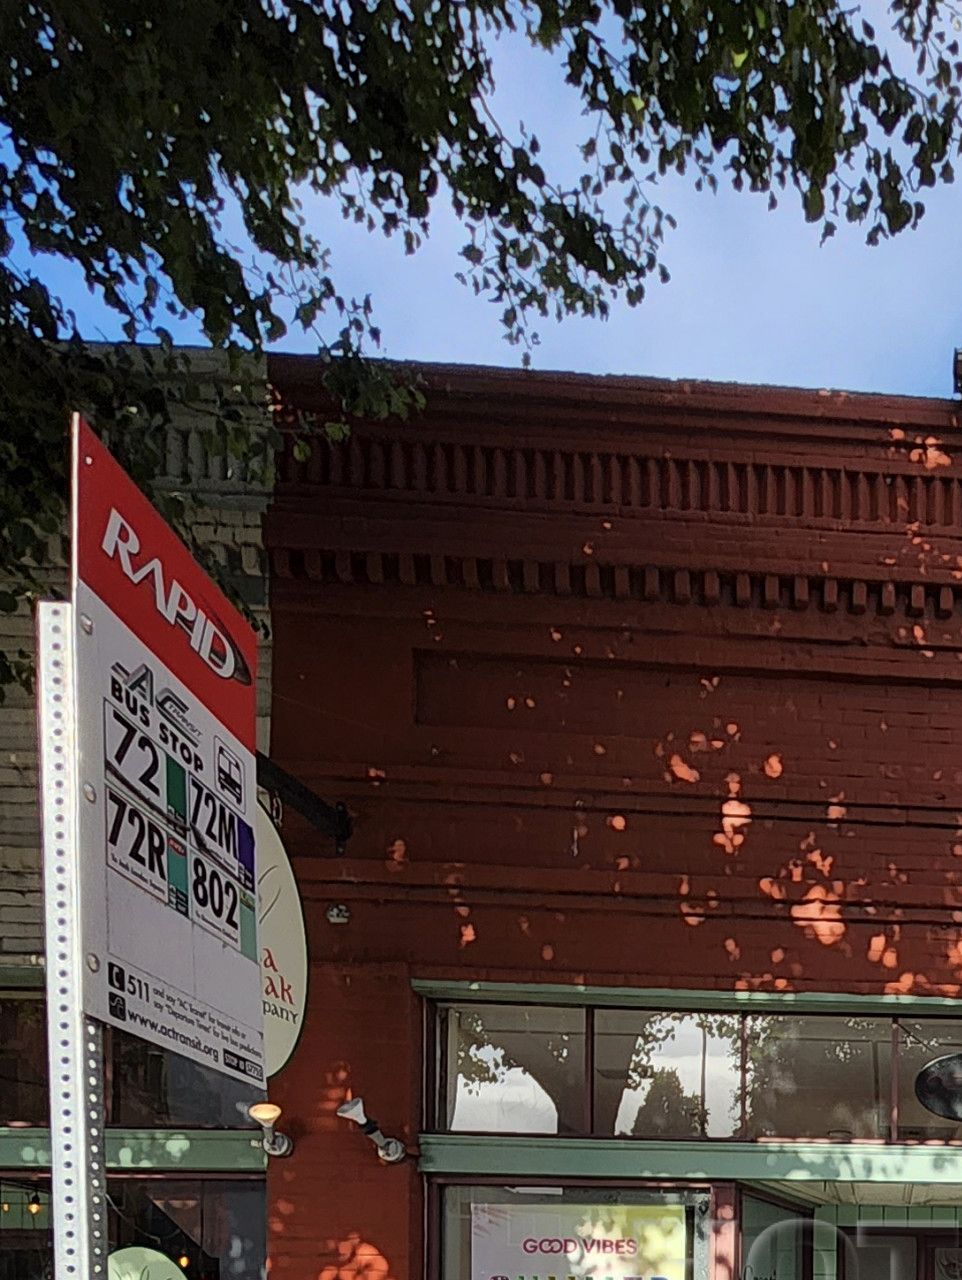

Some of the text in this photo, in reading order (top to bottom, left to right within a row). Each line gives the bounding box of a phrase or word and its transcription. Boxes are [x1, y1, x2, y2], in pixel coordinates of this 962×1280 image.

[102, 508, 237, 678] RAPID
[111, 676, 204, 773] BUS STOP
[112, 709, 161, 797] 72
[108, 789, 167, 881] 72R
[190, 777, 239, 861] 72M
[193, 857, 239, 931] 802
[127, 975, 150, 1004] 511
[127, 1008, 219, 1064] www.actransit.org
[522, 1238, 638, 1256] GOOD VIBES
